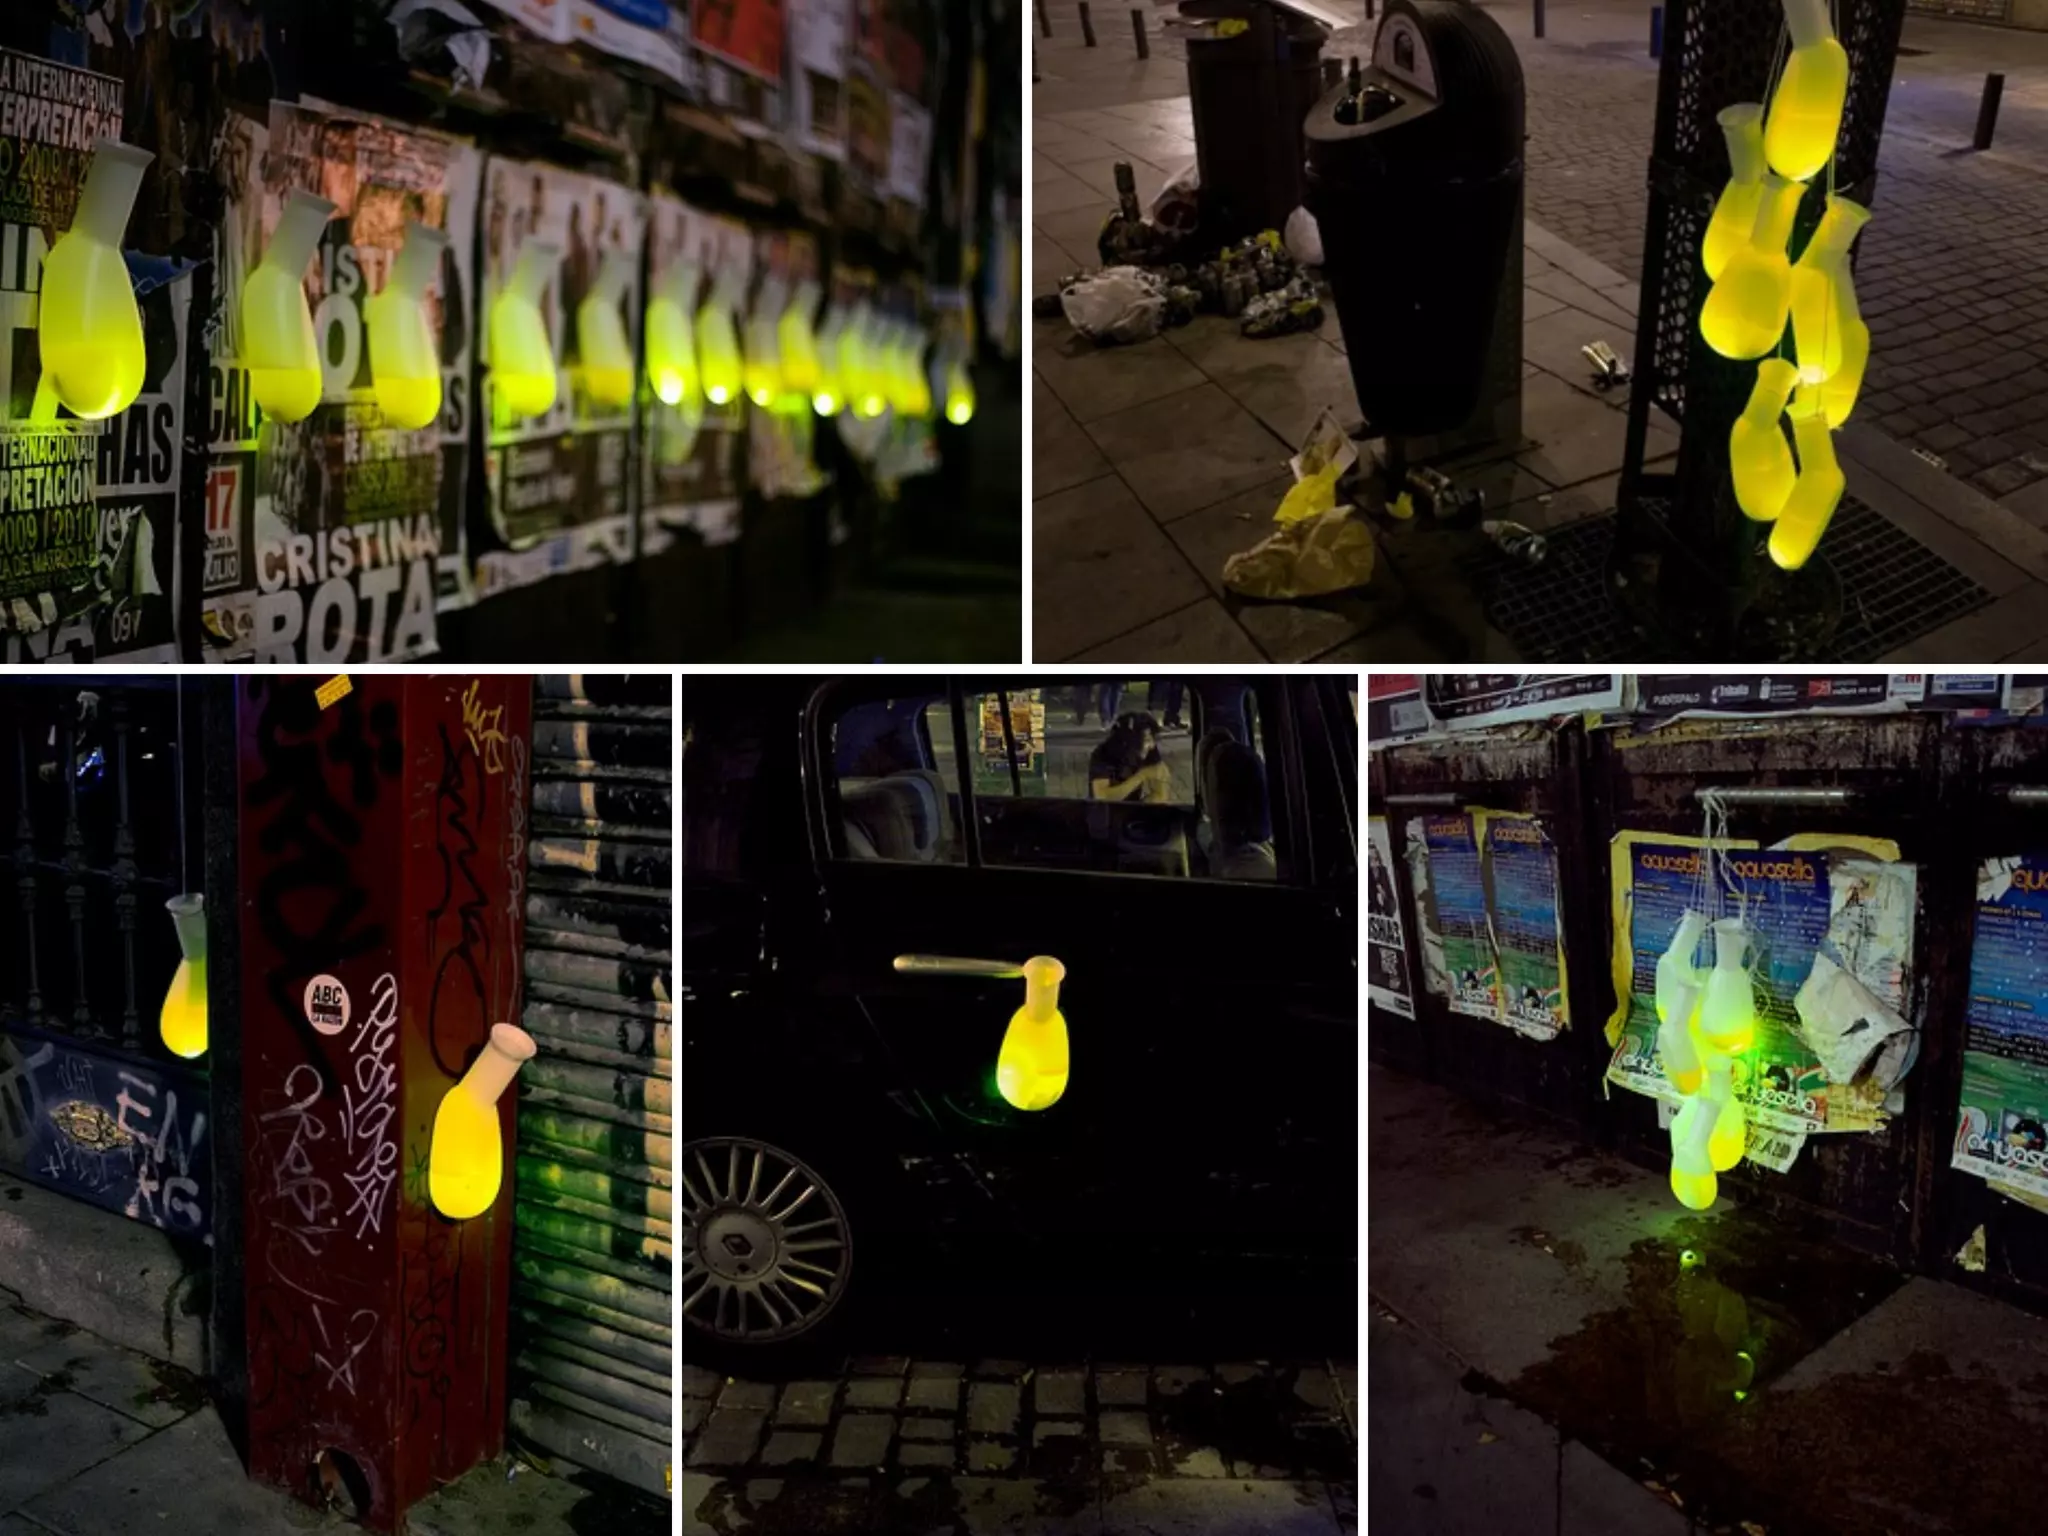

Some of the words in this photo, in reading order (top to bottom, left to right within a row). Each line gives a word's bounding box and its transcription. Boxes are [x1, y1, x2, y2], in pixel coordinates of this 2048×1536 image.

[0, 90, 123, 152] ERPRETACIÓN
[255, 512, 440, 594] CRISTINA
[254, 558, 441, 662] ROTA
[312, 984, 343, 1005] ABC
